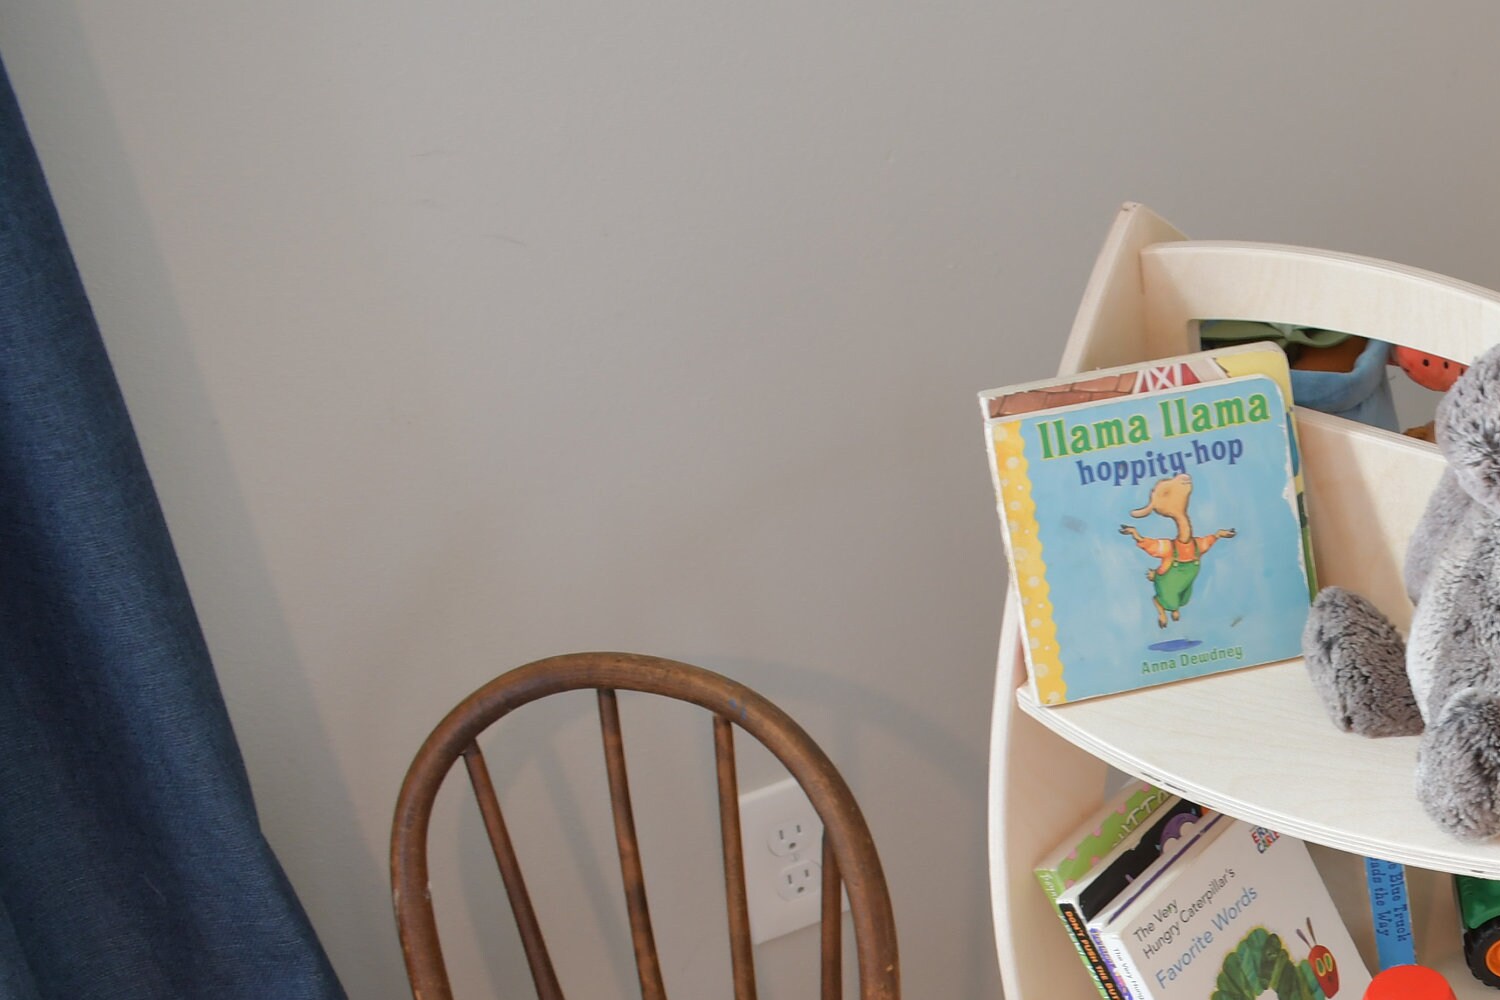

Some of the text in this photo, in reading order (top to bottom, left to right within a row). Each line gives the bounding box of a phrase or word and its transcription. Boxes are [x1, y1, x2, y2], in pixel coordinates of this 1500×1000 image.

[1036, 393, 1271, 460] llama llama
[1075, 437, 1244, 487] hoppity-hop
[1141, 645, 1243, 675] Anna Dewdney
[1374, 887, 1389, 907] the
[1389, 871, 1405, 902] Blue
[1132, 899, 1179, 943] The Very
[1141, 920, 1181, 960] Hungry
[1178, 867, 1236, 924] Caterpillar's
[1375, 910, 1393, 937] Way
[1393, 903, 1412, 942] Truck
[1064, 911, 1085, 937] DON'T
[1080, 939, 1099, 962] PUSH
[1094, 965, 1110, 981] THE
[1154, 886, 1258, 990] Favorite Words
